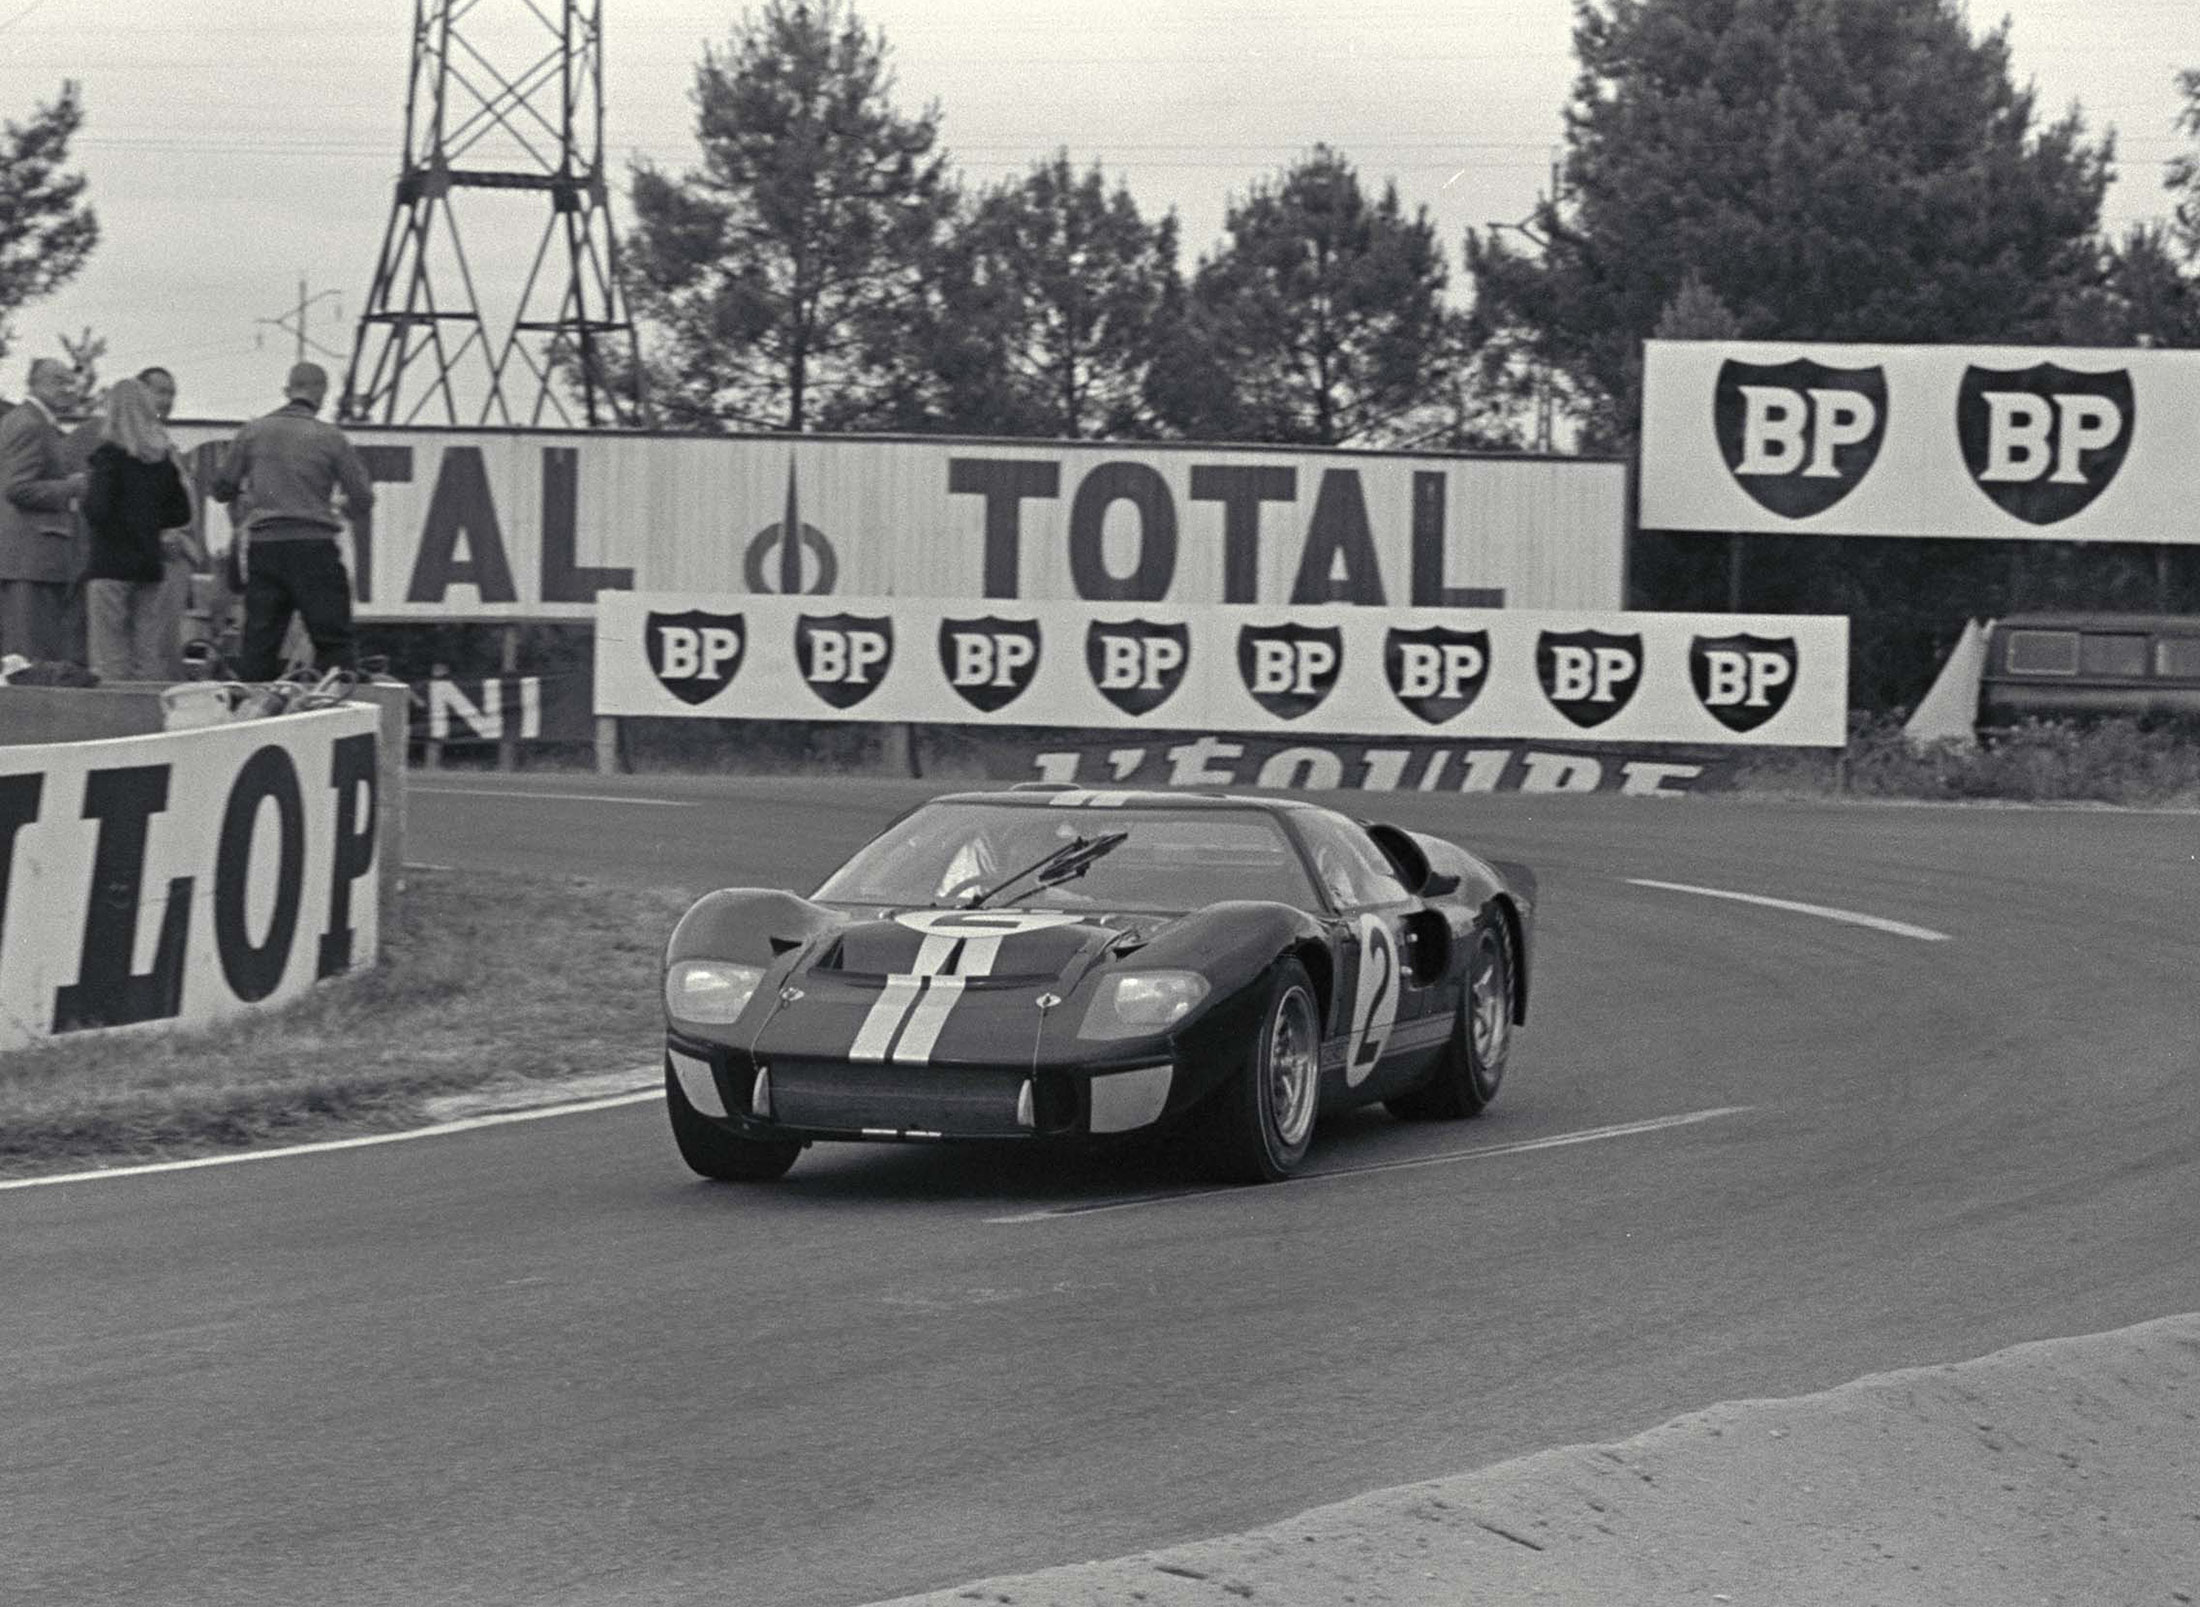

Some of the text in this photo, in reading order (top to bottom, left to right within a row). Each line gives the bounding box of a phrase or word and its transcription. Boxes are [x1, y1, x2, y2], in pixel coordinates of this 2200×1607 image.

[1734, 385, 2122, 484] BP BP
[948, 457, 1505, 608] TOTAL
[657, 627, 1790, 706] BP BP BP BP BP BP BP BP
[1354, 926, 1390, 1066] 2
